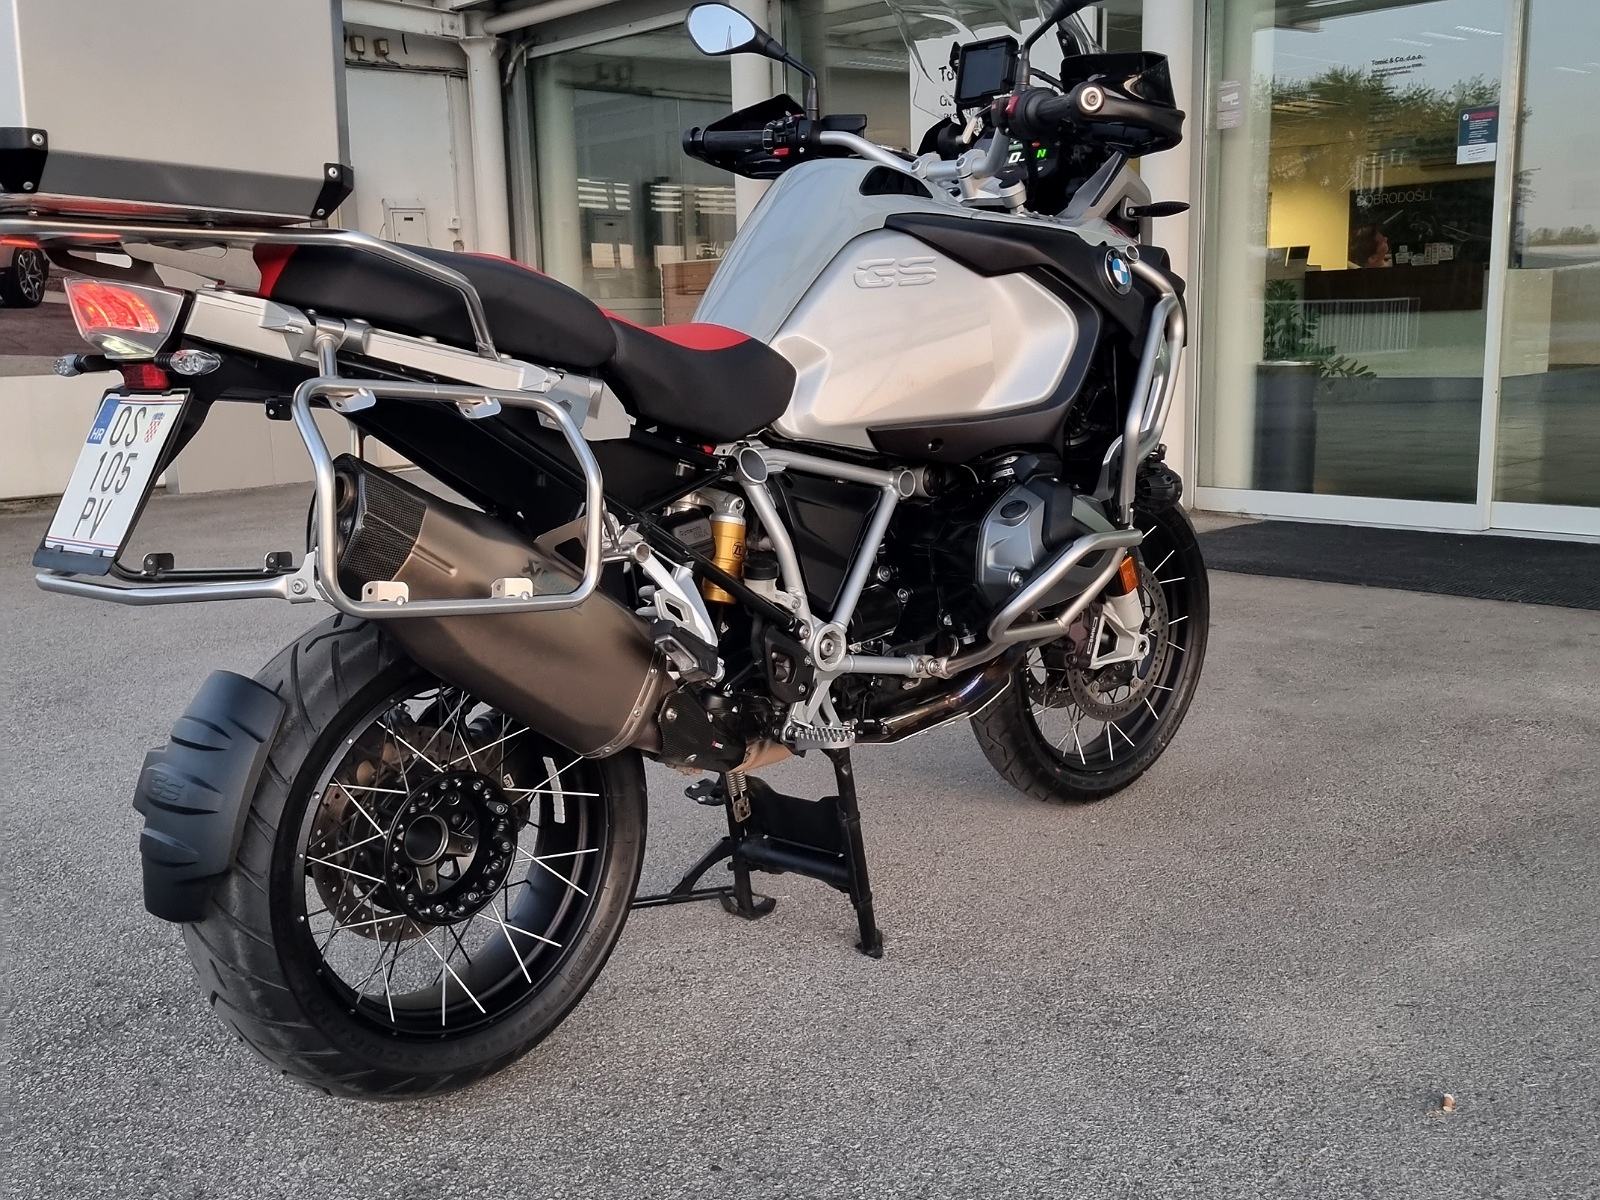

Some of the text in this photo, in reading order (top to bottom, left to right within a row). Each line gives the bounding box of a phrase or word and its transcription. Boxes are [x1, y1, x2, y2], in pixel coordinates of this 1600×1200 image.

[1036, 149, 1046, 158] N
[853, 256, 937, 289] GS
[90, 428, 105, 441] HR
[109, 405, 147, 447] OS
[89, 451, 139, 494] 105
[73, 497, 113, 540] PV
